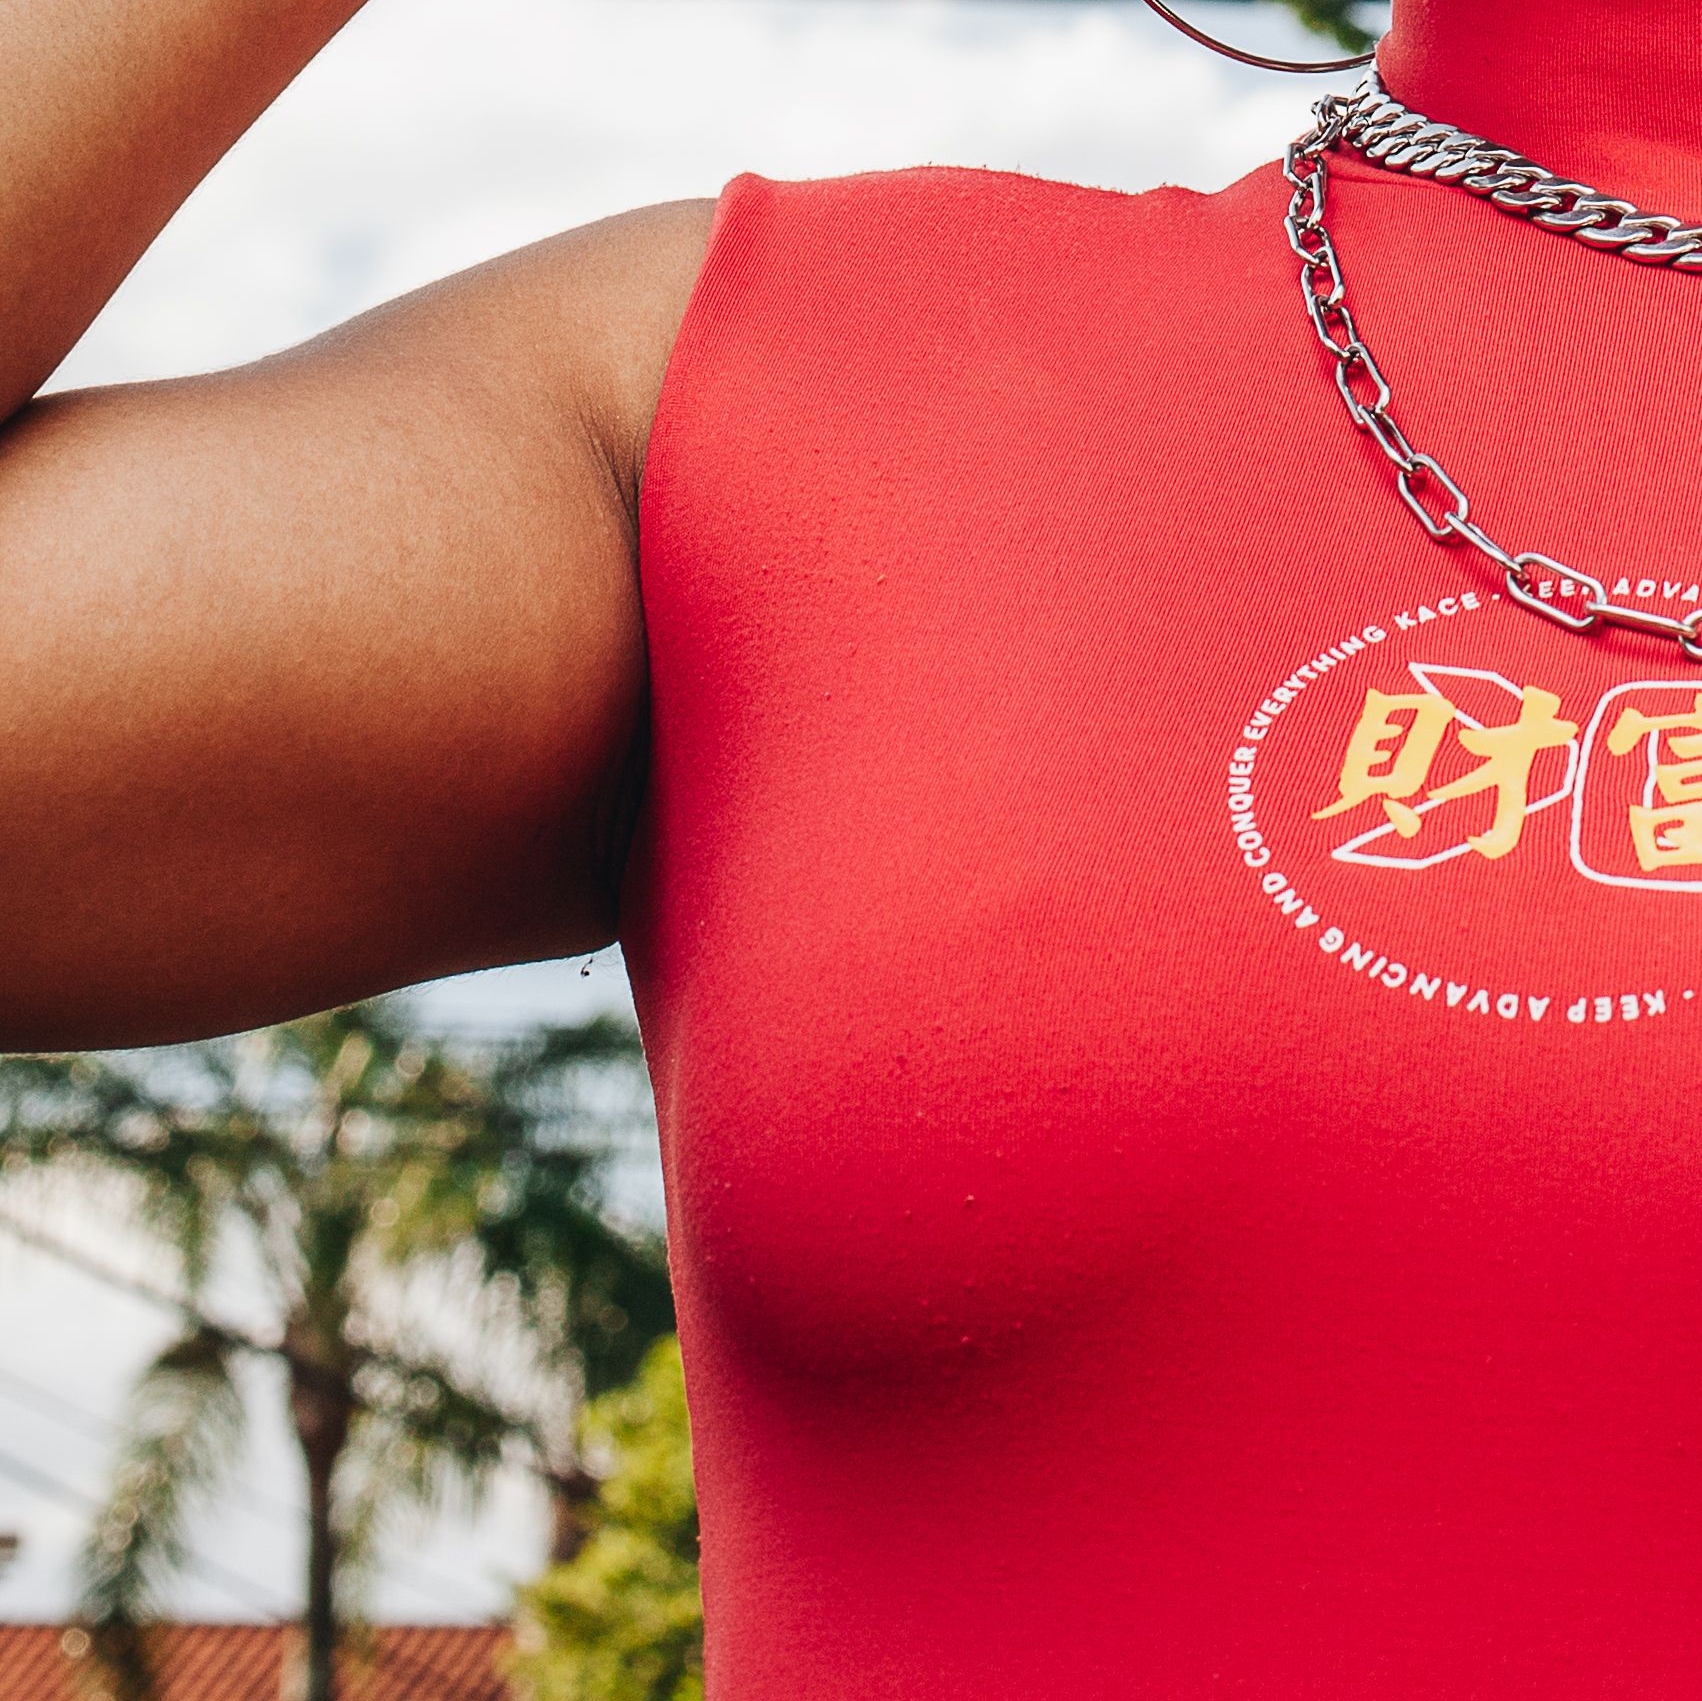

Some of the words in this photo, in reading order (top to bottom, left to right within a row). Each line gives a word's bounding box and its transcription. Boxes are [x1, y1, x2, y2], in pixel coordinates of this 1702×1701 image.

[1393, 591, 1481, 631] KACE
[1243, 625, 1387, 741] EVERYTHING
[1227, 746, 1271, 868] CONQUER
[1262, 872, 1319, 929] AND
[1318, 926, 1551, 1021] ADVANCING
[1566, 989, 1666, 1023] KEEP
